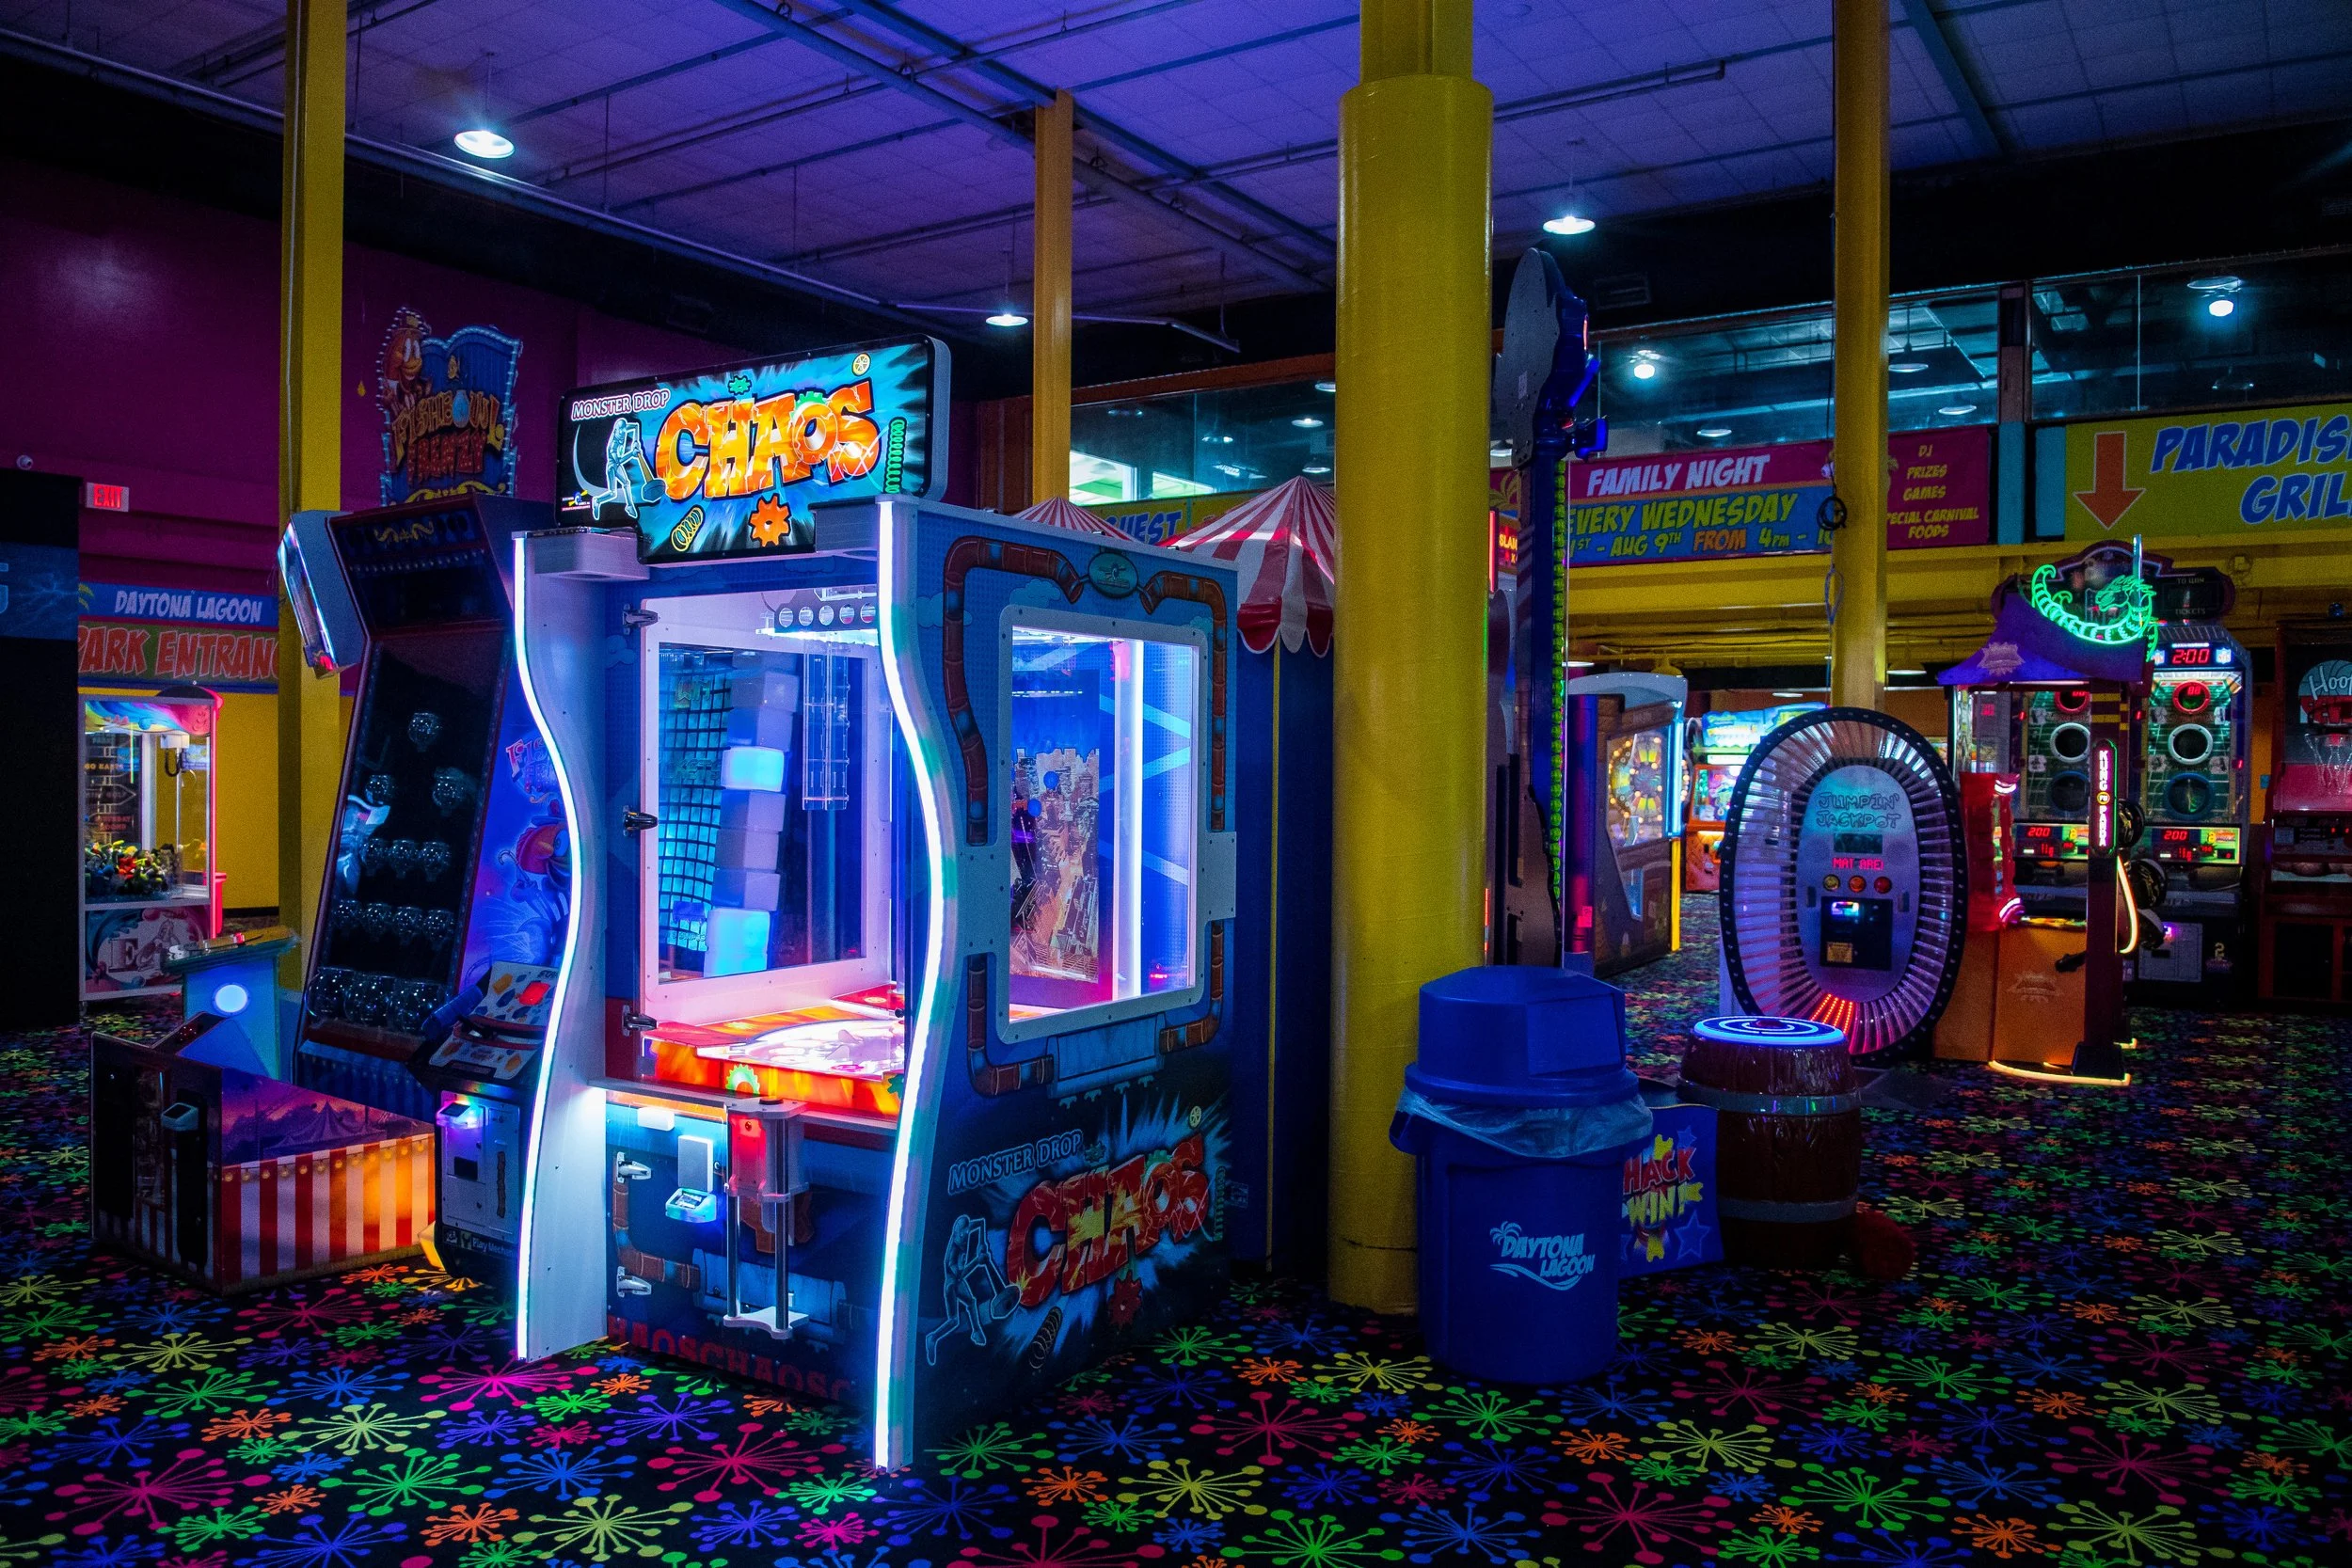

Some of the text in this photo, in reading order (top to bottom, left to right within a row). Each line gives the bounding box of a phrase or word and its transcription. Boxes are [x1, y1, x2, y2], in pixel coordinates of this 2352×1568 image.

[571, 389, 670, 420] MONSTER DROP
[656, 378, 880, 500] CHAOS
[1918, 444, 1933, 458] DJ
[2150, 414, 2352, 474] PARADIS
[407, 427, 487, 485] FRENZY
[1906, 464, 1947, 480] PRIZES
[1587, 454, 1771, 498] FAMILY NIGHT
[94, 483, 123, 509] EXIT
[1902, 484, 1947, 501] GAMES
[2239, 471, 2352, 525] GRIL
[1104, 511, 1183, 545] UEST
[1641, 493, 1799, 532] WEDNESDAY
[1887, 506, 1979, 526] PECIAL CARNIVAL
[1610, 534, 1647, 557] AUG
[1654, 531, 1682, 553] 9TH
[1693, 529, 1747, 553] FROM
[1907, 524, 1949, 539] FOODS
[114, 590, 262, 623] DAYTONA LAGOON
[2171, 648, 2210, 664] 2:00
[2099, 750, 2108, 791] KUNG
[1817, 810, 1901, 829] JACKPOT
[2099, 805, 2107, 847] PANDA
[2164, 830, 2188, 840] 200
[949, 1131, 1083, 1195] MONSTER DROP
[1623, 1147, 1697, 1196] HACK
[1007, 1132, 1210, 1307] CHAOS
[1501, 1233, 1584, 1259] DAYTONA
[1540, 1254, 1596, 1277] LAGOON
